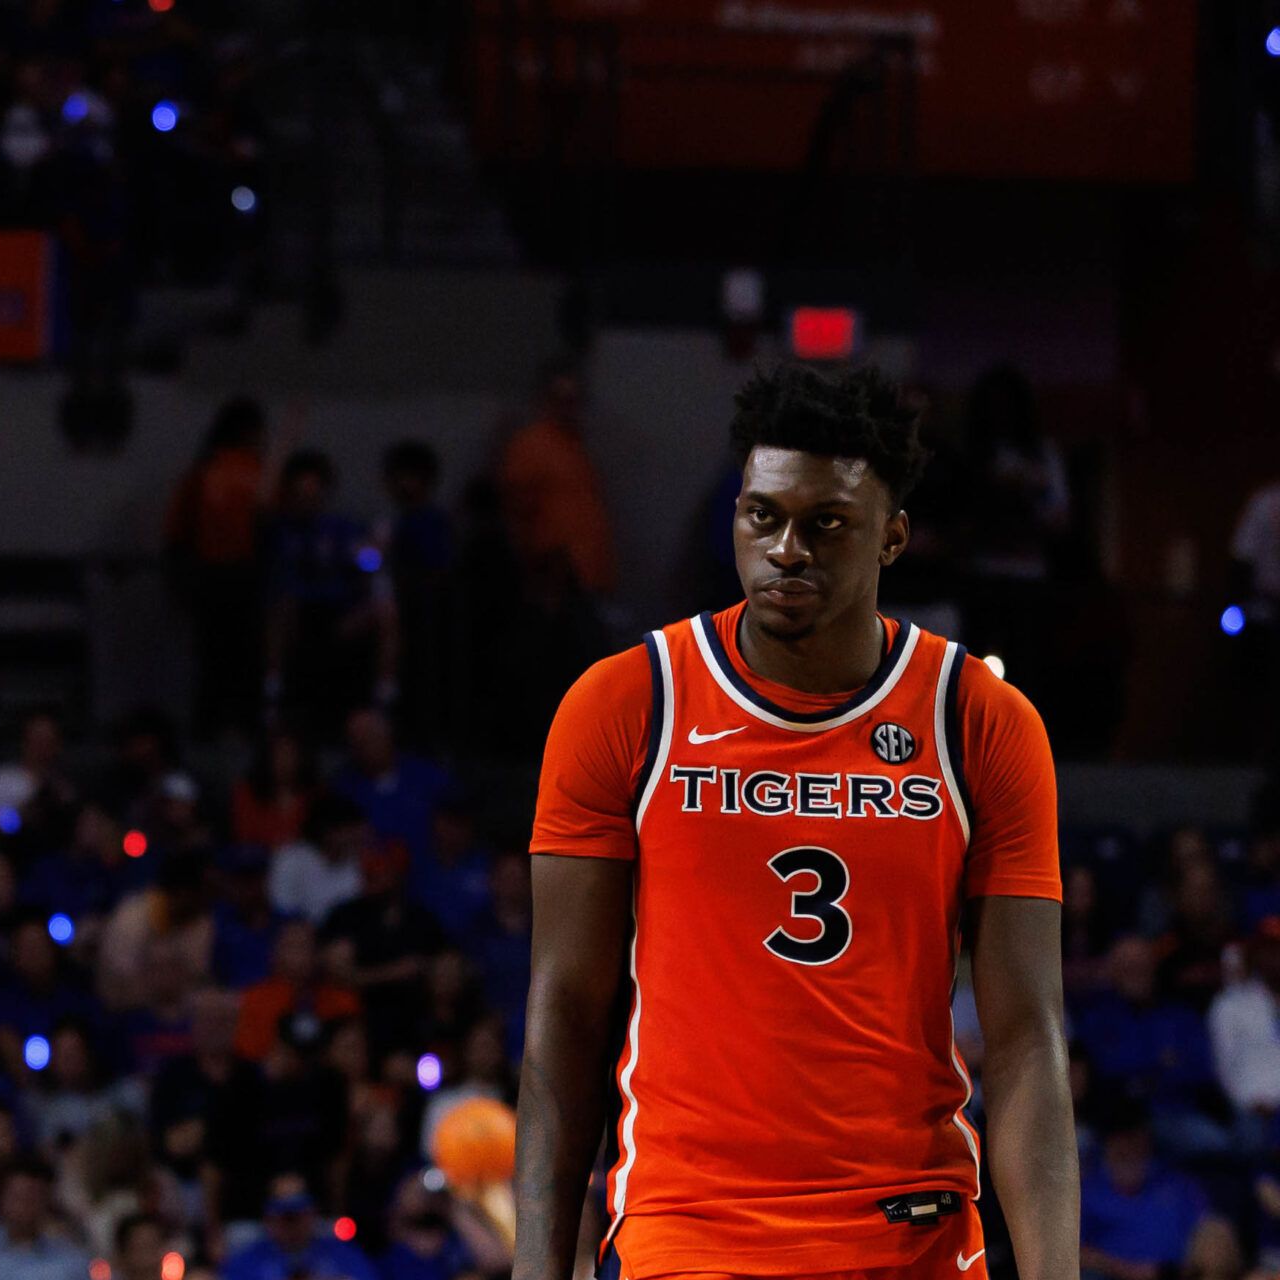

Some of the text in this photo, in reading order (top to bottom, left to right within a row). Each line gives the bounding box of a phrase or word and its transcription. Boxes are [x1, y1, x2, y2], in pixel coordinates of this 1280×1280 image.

[874, 723, 913, 762] SEC
[670, 765, 943, 820] TIGERS
[762, 845, 853, 966] 3
